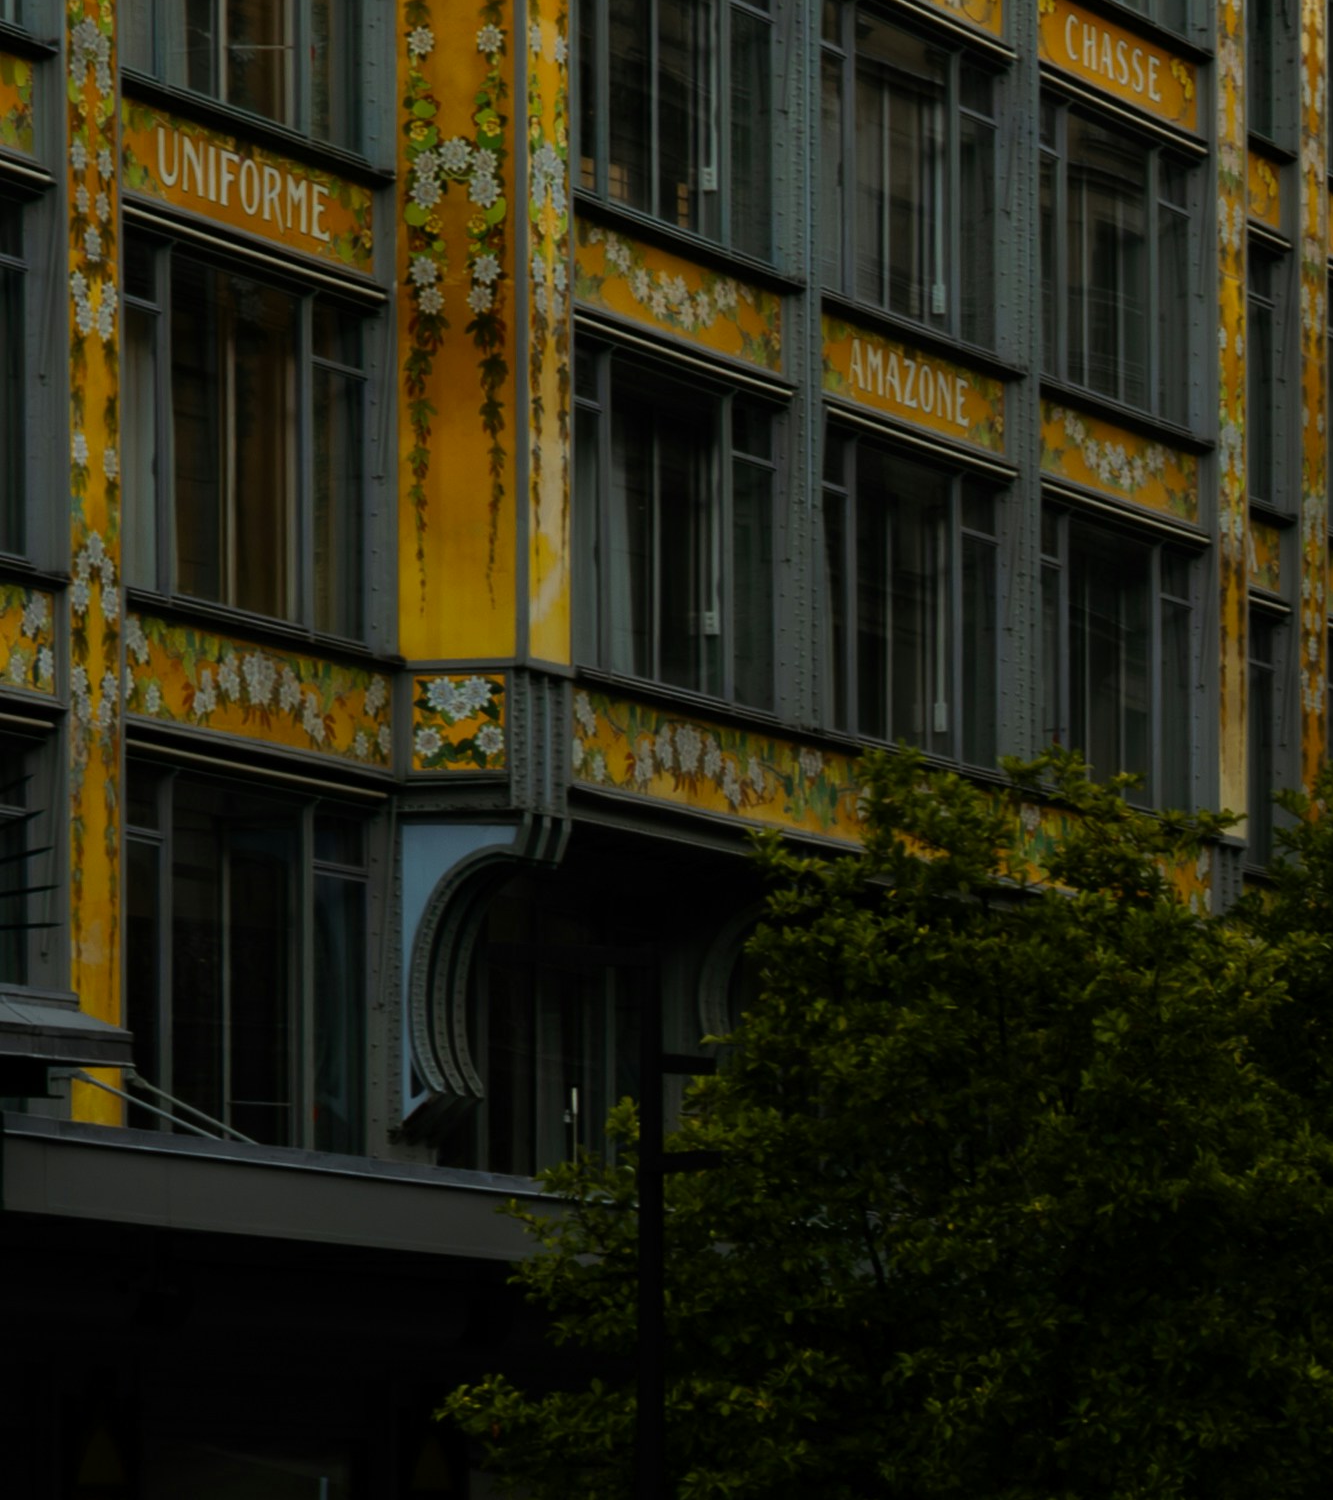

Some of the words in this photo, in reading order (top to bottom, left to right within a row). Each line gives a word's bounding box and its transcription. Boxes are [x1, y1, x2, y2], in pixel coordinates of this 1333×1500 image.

[1064, 15, 1161, 104] CHASSE
[156, 126, 331, 242] UNIFORME
[848, 338, 970, 428] AMAZONE
